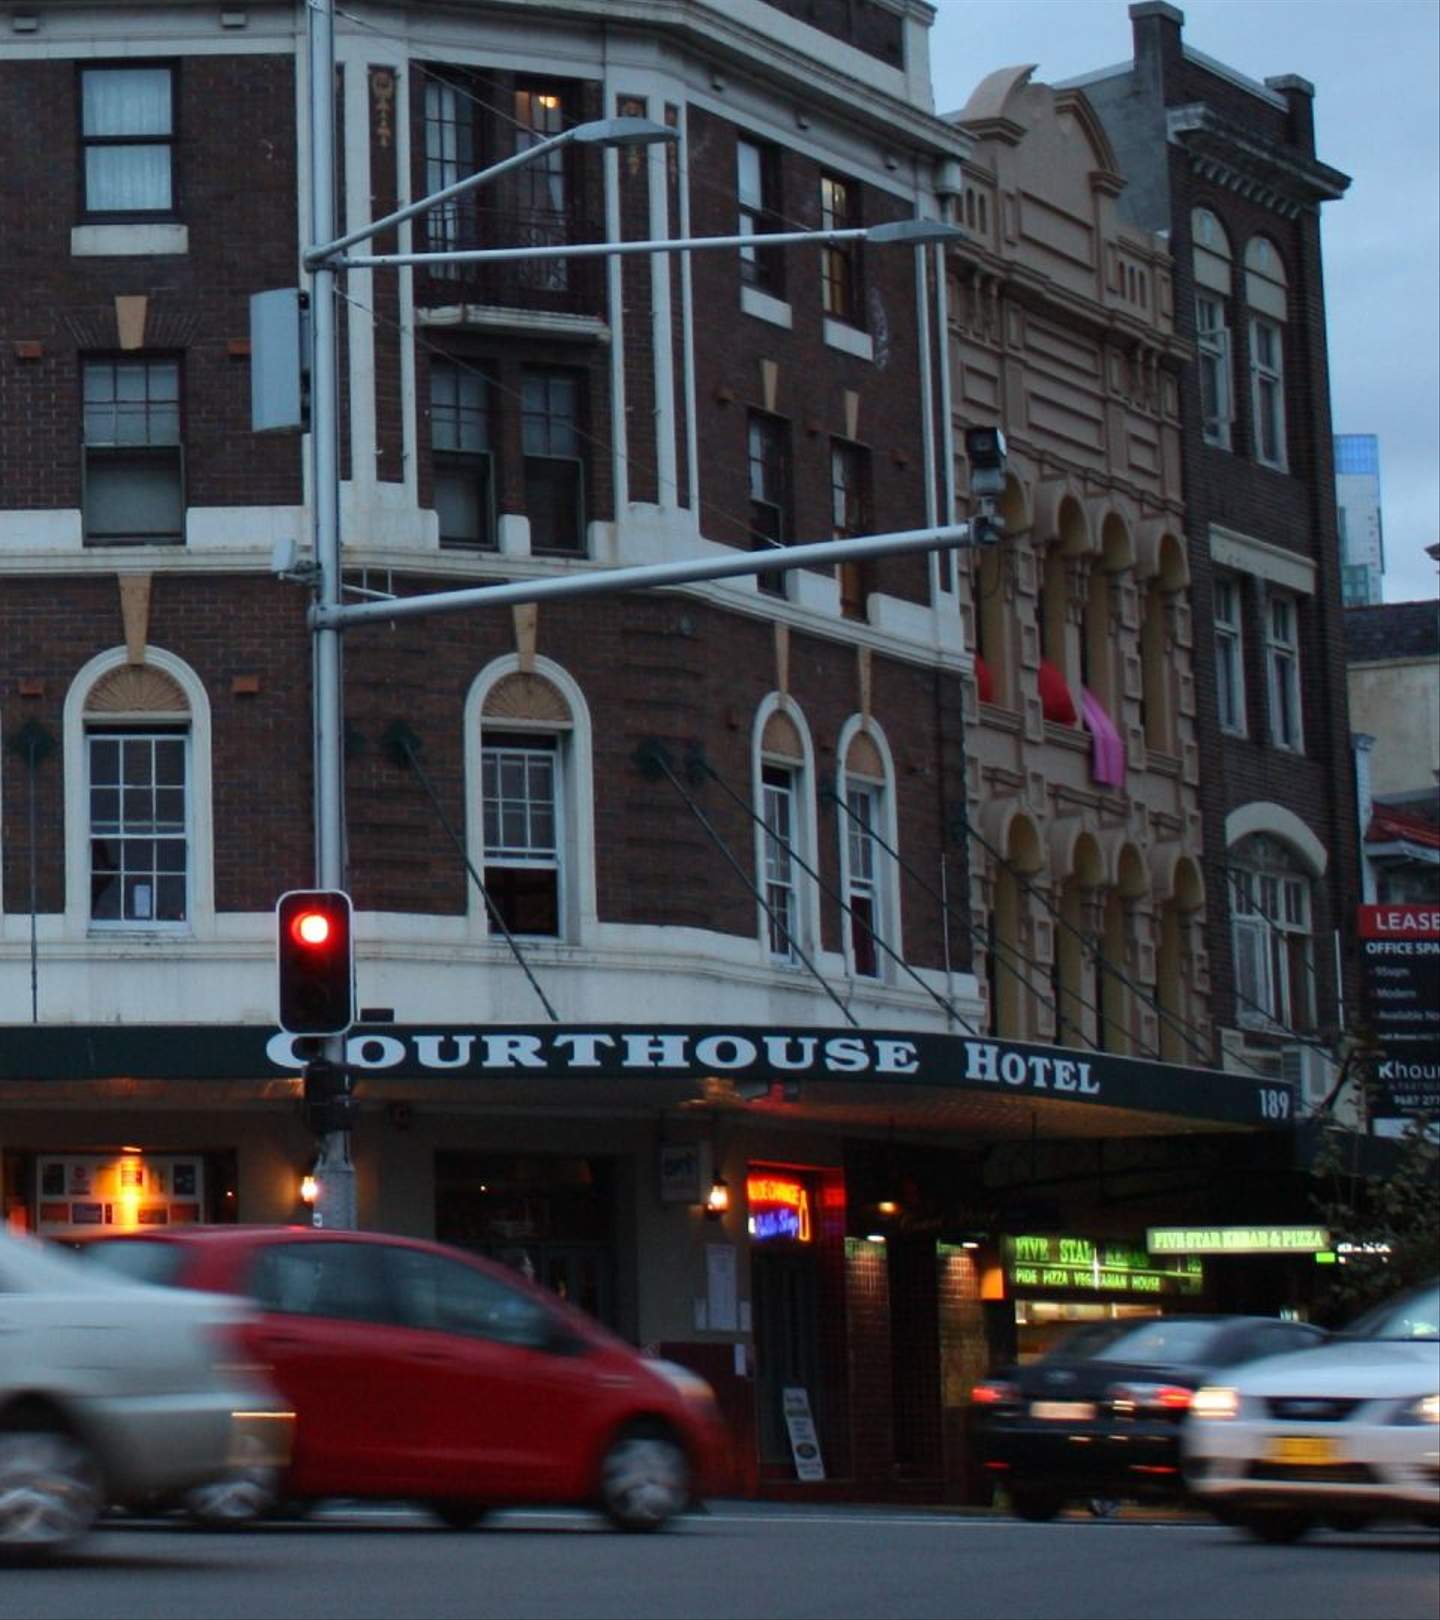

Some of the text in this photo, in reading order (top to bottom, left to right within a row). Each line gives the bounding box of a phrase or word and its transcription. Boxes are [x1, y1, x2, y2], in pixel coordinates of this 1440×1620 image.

[1376, 912, 1440, 930] LEASE
[1366, 943, 1413, 954] OFFICE
[266, 1032, 1100, 1094] COURTHOUSE HOTEL
[1259, 1089, 1290, 1120] 189
[1015, 1236, 1049, 1261] FIVE
[1154, 1232, 1184, 1248] FIVE
[1186, 1232, 1221, 1248] STAR
[1269, 1231, 1281, 1248] &
[1282, 1231, 1324, 1248] PIZZA
[1042, 1270, 1068, 1286] PIZZA
[1131, 1275, 1160, 1292] HOUSE
